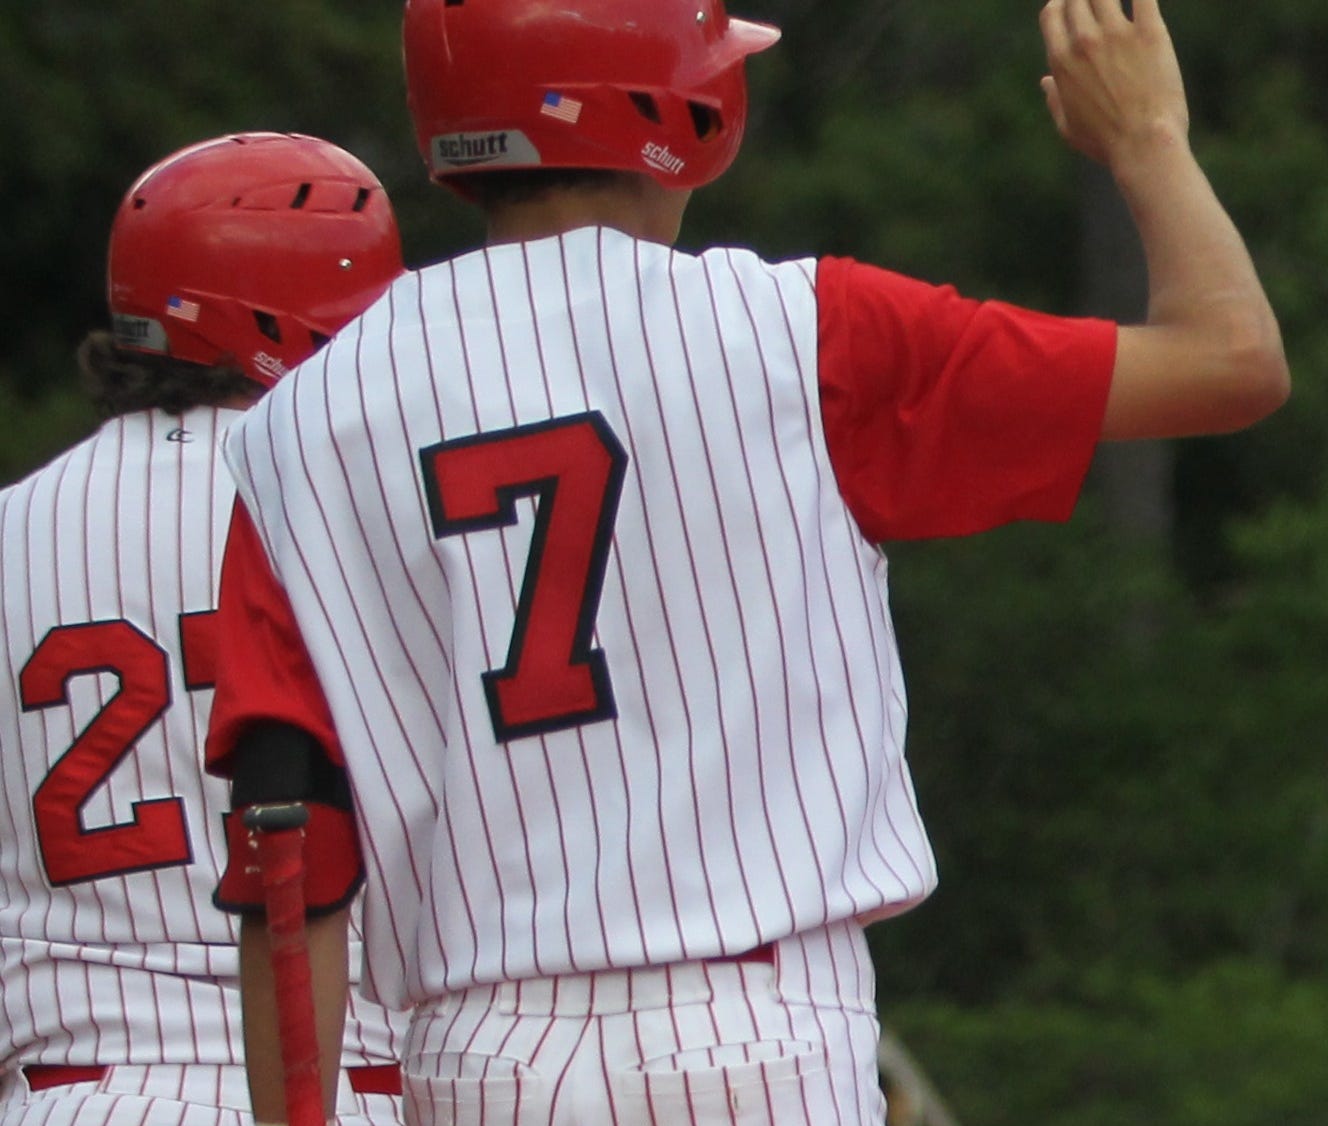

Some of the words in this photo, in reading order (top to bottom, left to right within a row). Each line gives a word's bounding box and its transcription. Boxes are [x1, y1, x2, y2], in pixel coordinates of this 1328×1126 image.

[439, 131, 508, 158] schutt
[641, 141, 685, 175] schutt
[420, 409, 629, 745] 7
[19, 608, 217, 888] 2
